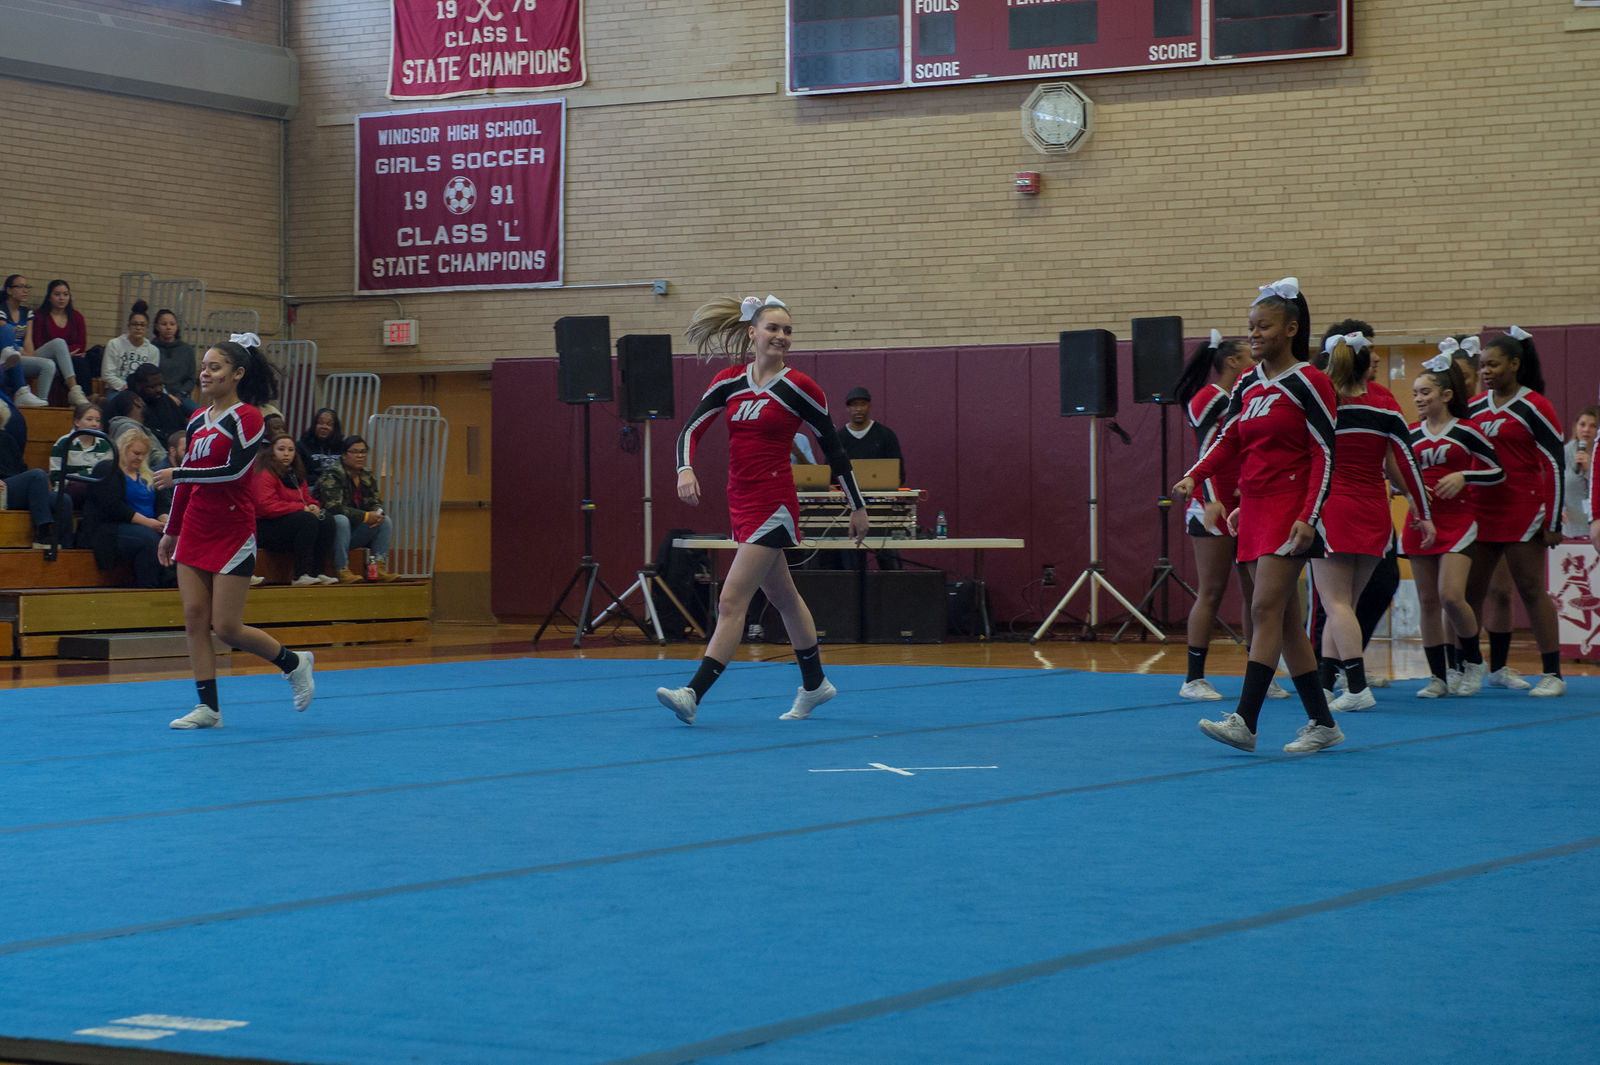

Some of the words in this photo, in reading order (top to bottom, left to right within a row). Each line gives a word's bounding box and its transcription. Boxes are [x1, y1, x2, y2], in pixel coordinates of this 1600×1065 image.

[437, 0, 458, 19] 19
[915, 0, 960, 14] FOULS
[445, 26, 508, 48] CLASS
[515, 26, 529, 43] L
[1028, 52, 1079, 71] MATCH
[1148, 42, 1198, 62] SCORE
[402, 55, 462, 85] STATE
[468, 47, 572, 78] CHAMPIONS
[915, 61, 960, 80] SCORE
[378, 126, 440, 146] WINDSOR
[447, 123, 479, 142] HIGH
[485, 118, 542, 139] SCHOOL
[375, 155, 441, 175] GIRLS
[451, 147, 545, 170] SOCCER
[403, 190, 428, 211] 19
[490, 184, 515, 205] 91
[396, 223, 488, 247] CLASS
[372, 254, 431, 278] STATE
[437, 249, 547, 274] CHAMPIONS
[390, 323, 410, 343] EXIT
